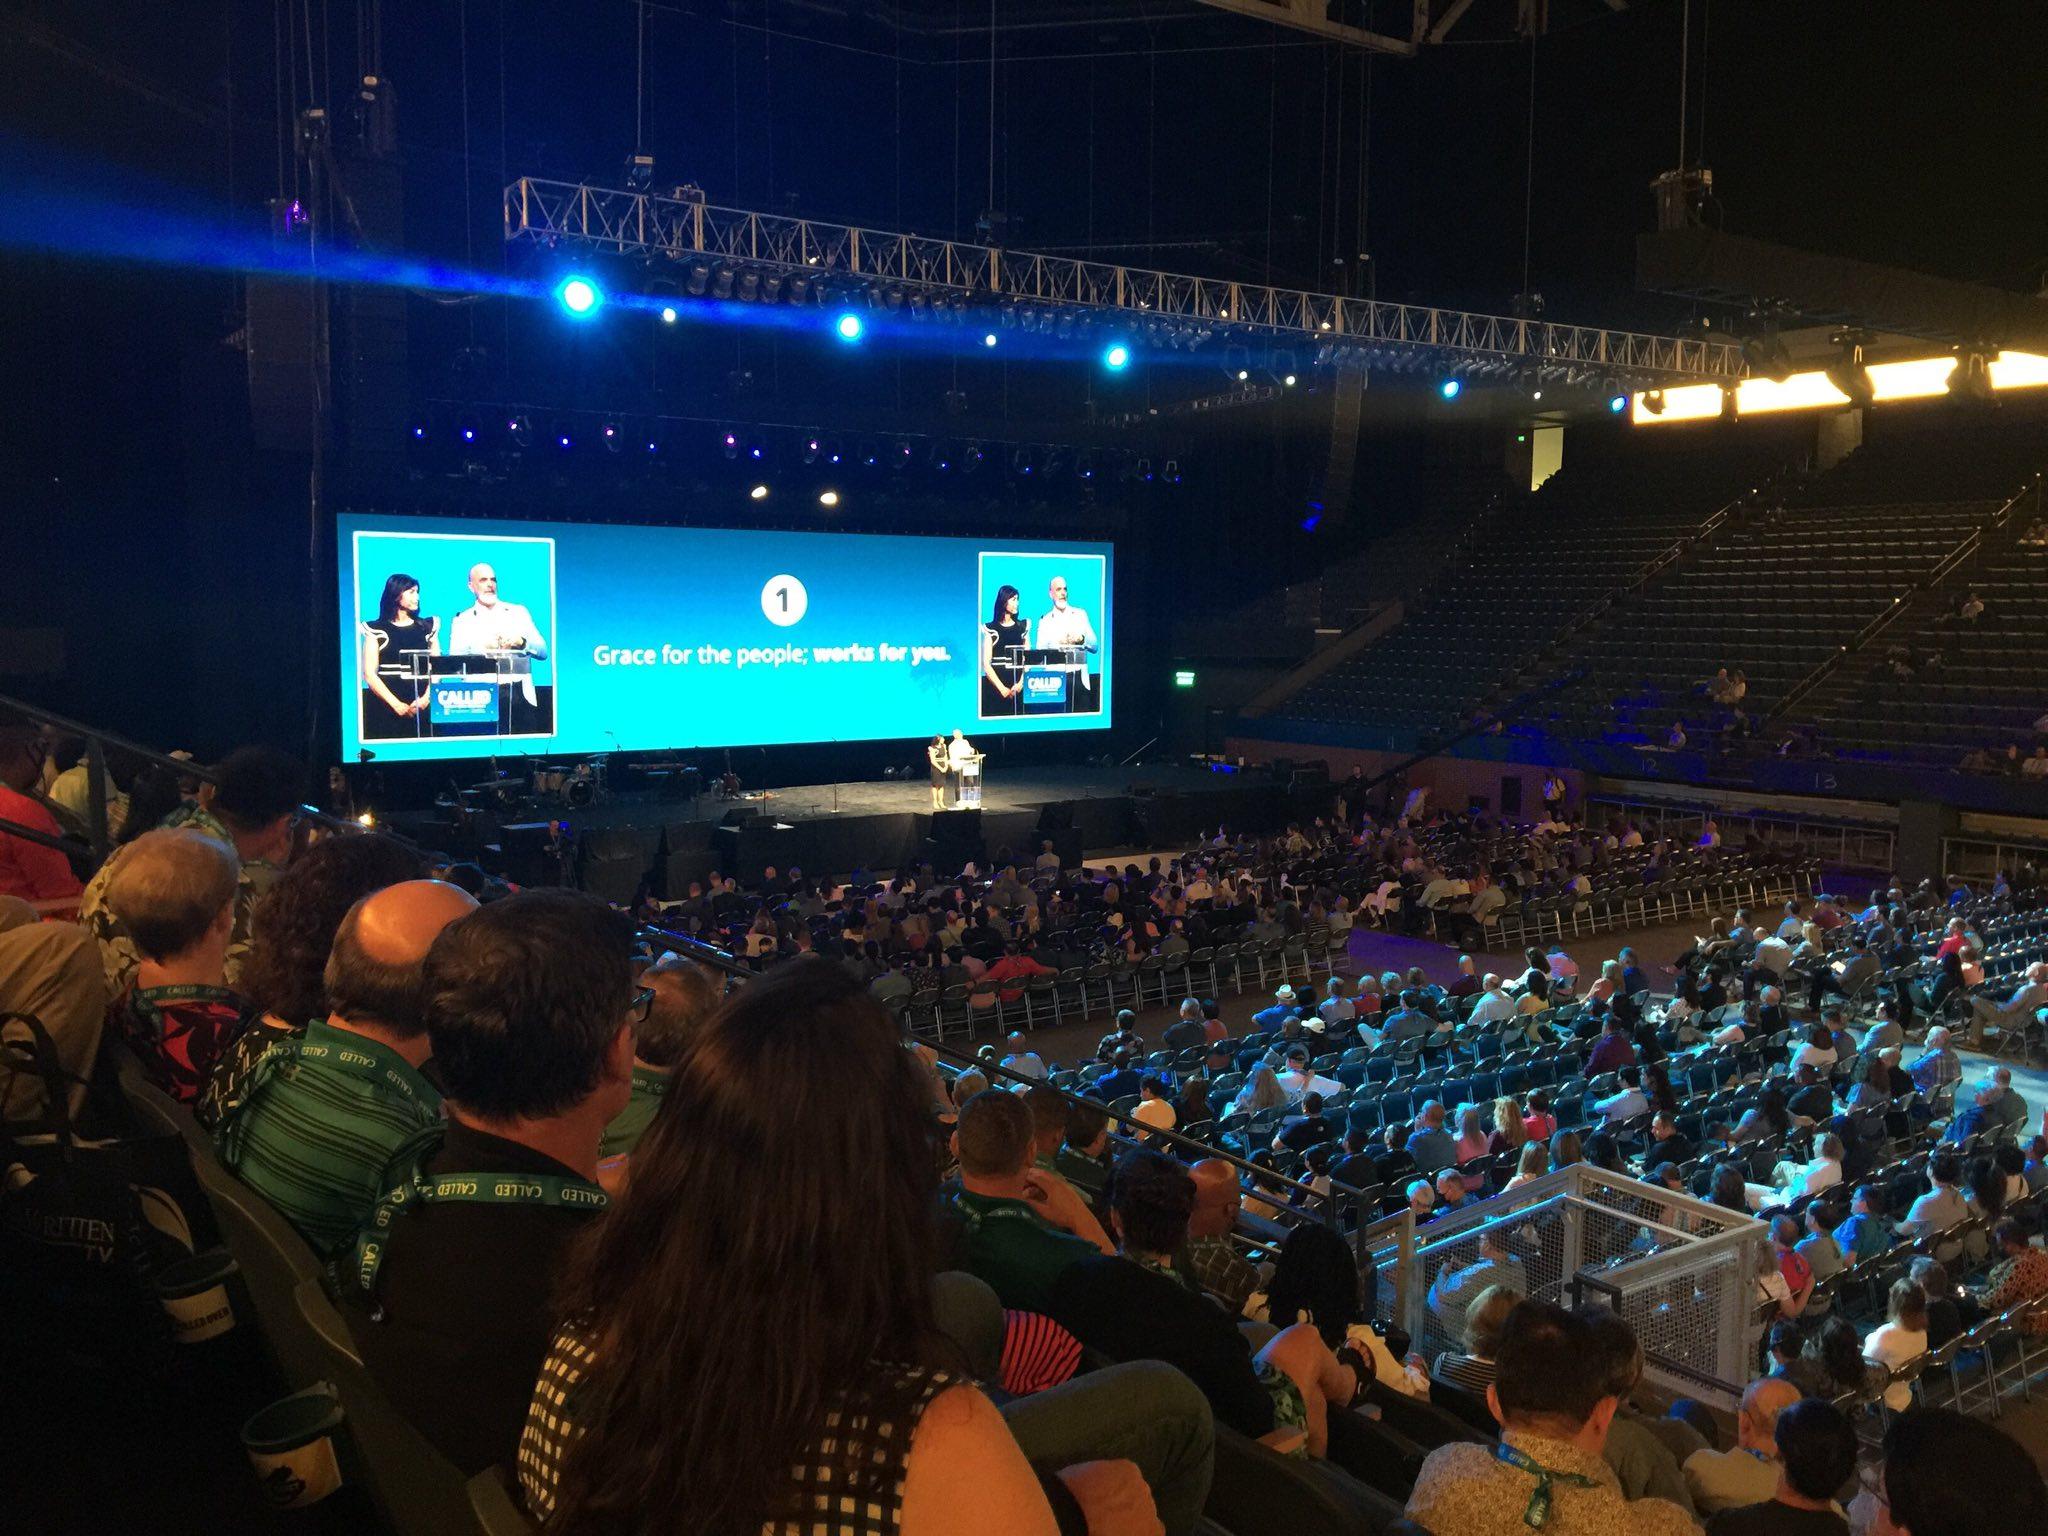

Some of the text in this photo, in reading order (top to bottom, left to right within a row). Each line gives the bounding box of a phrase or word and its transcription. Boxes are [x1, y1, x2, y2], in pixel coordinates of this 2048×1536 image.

[776, 587, 788, 612] 1
[593, 643, 951, 669] Grace for the people; works for you.
[437, 689, 492, 705] CALLED
[1815, 771, 1838, 789] 13
[339, 1051, 376, 1068] CALLED
[386, 1070, 413, 1096] CALLED
[437, 1182, 477, 1197] CALLED
[494, 1184, 543, 1198] CALLED
[561, 1188, 608, 1206] CALLED
[361, 1243, 380, 1290] CALLED
